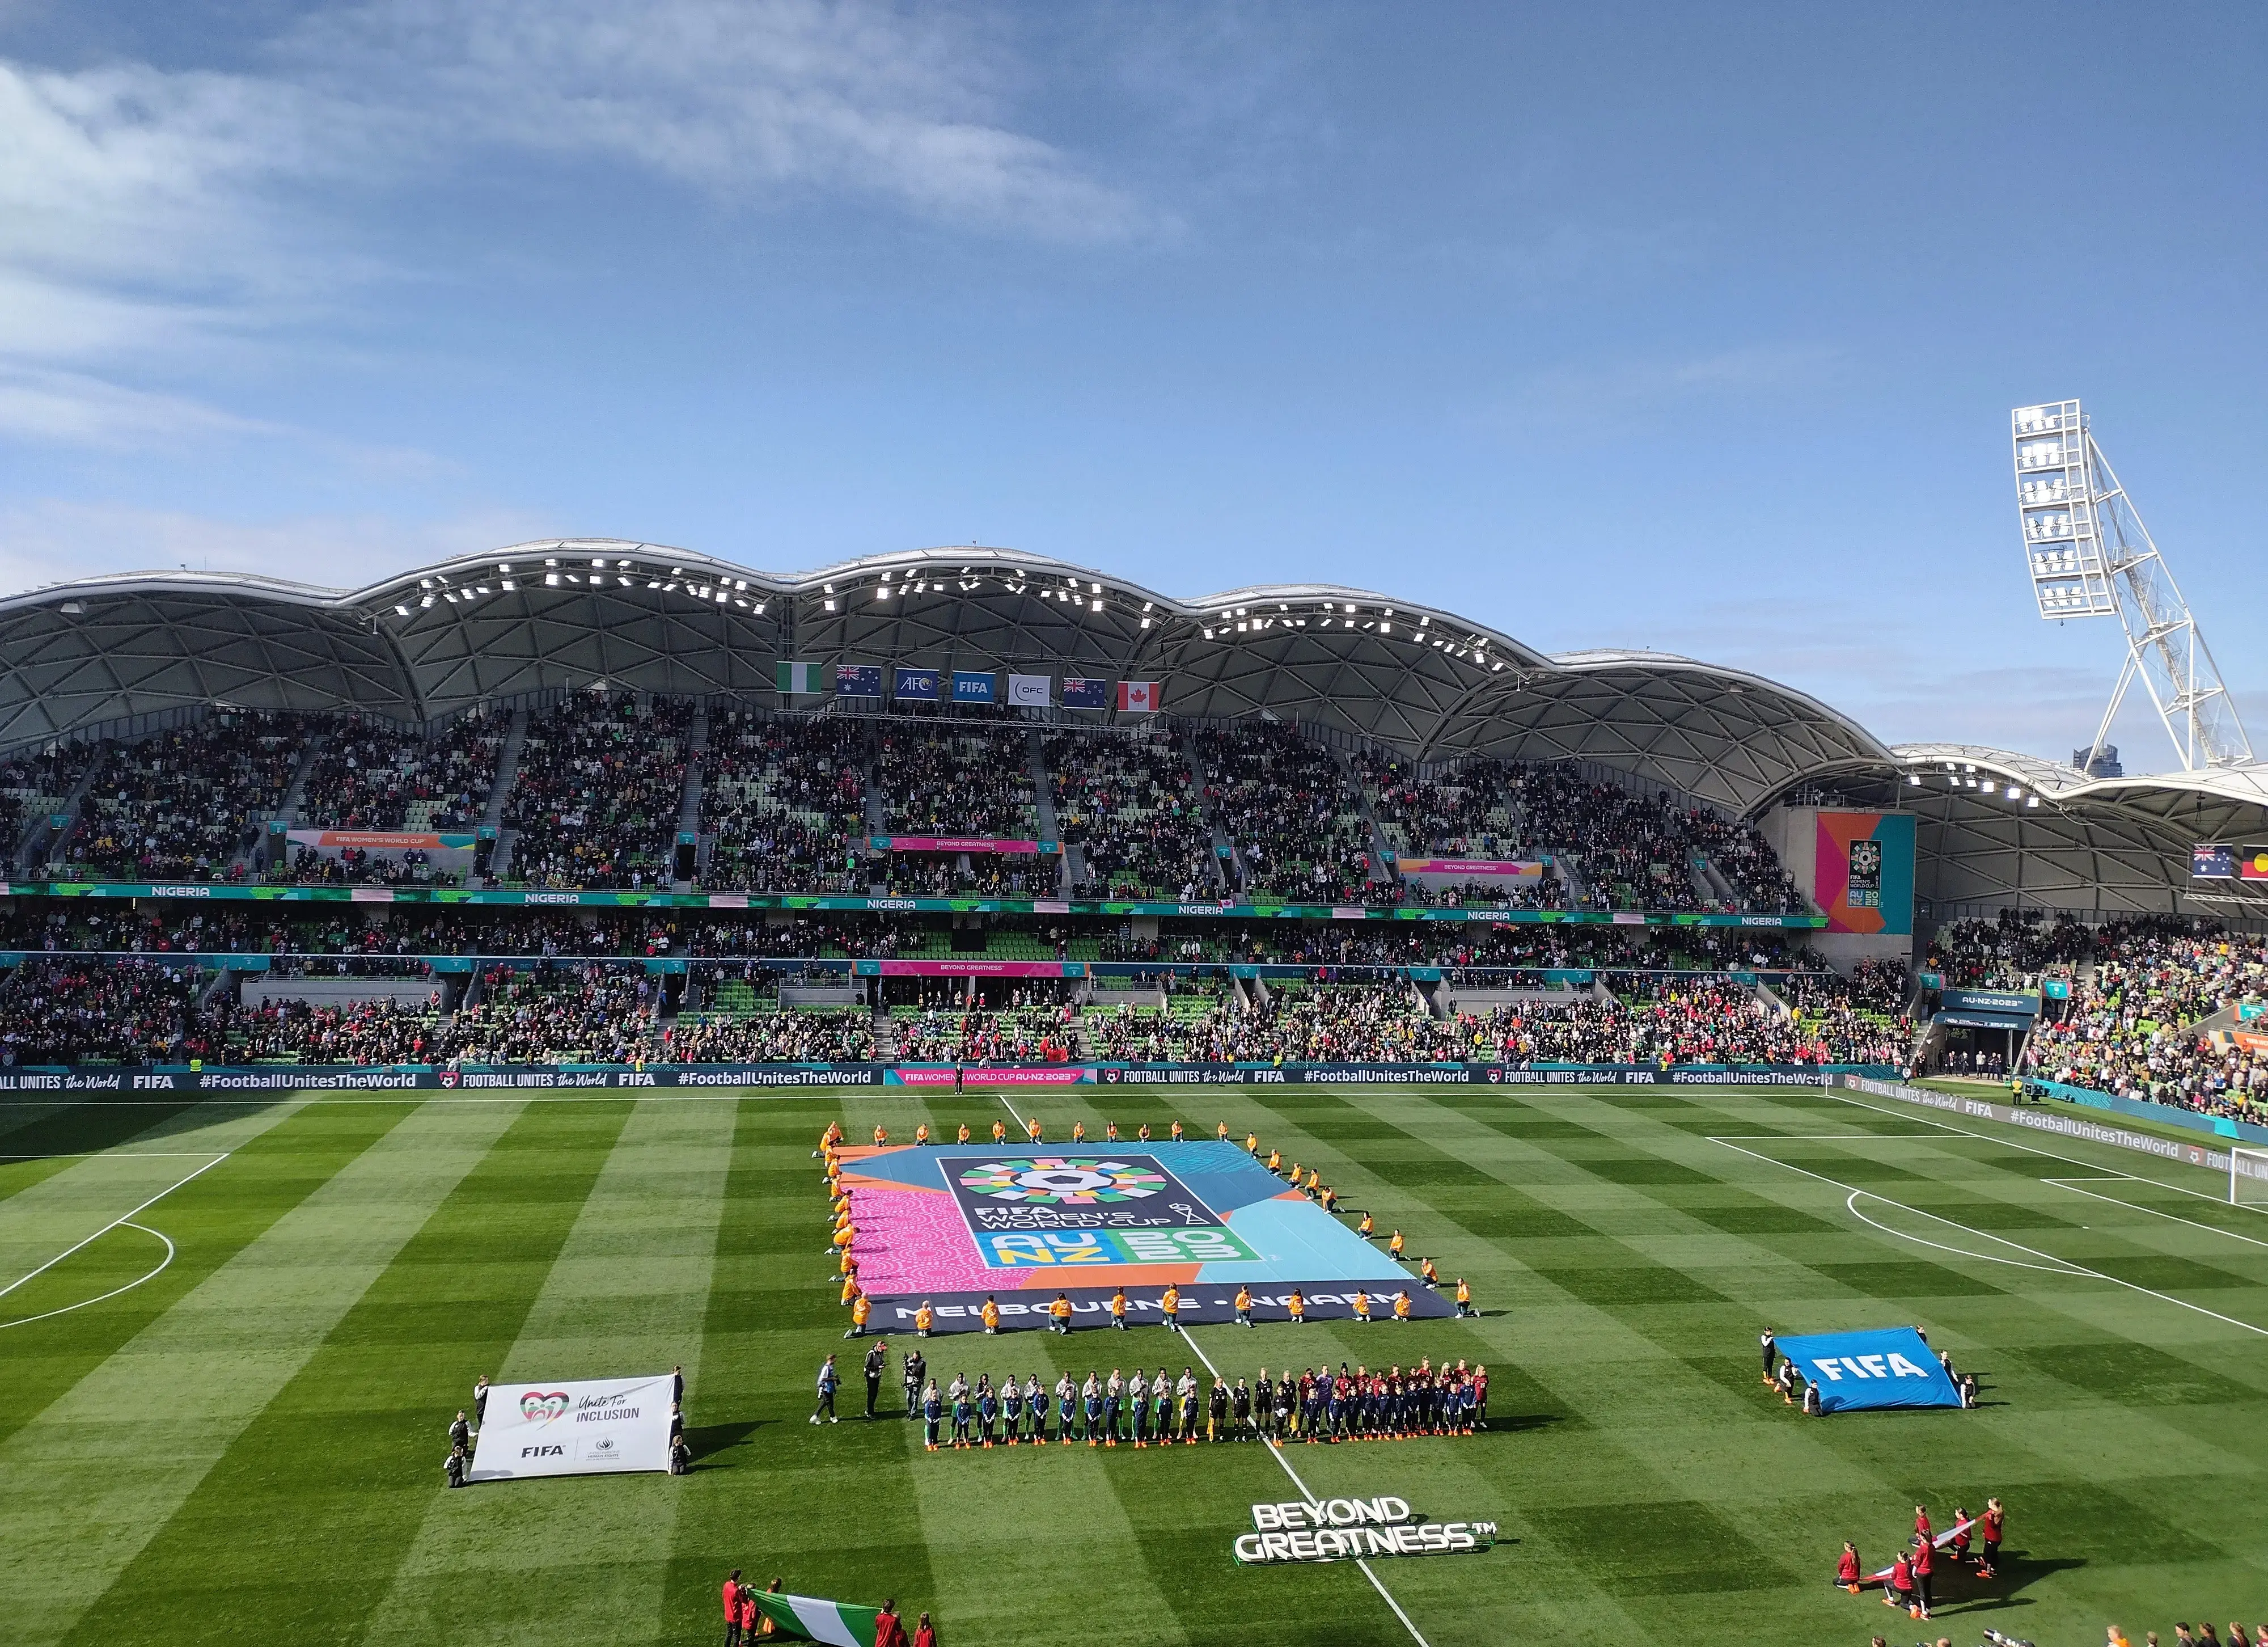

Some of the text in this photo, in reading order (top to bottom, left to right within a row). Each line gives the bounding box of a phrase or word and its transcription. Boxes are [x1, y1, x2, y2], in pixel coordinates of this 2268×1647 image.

[900, 677, 933, 691] AFC
[959, 682, 988, 694] FIFA
[152, 886, 210, 897] NIGERIA
[525, 894, 579, 903] NIGERIA
[867, 899, 916, 909] NIGERIA
[1179, 906, 1224, 915] NIGERIA
[1467, 911, 1510, 920] NIGERIA
[1742, 917, 1783, 926] NIGERIA
[20, 1075, 61, 1089] UNITES
[64, 1075, 84, 1088] the
[86, 1074, 121, 1089] World
[133, 1075, 175, 1088] FIFA
[200, 1074, 417, 1088] #FootballUnitesTheWorld
[463, 1072, 608, 1087] FOOTBALL UNITES the World
[619, 1073, 656, 1086] FIFA
[678, 1071, 871, 1086] #FootballUnitesTheWorld
[1124, 1069, 1245, 1083] FOOTBALL UNITES the World
[1254, 1070, 1285, 1083] FIFA
[1304, 1070, 1470, 1082] #FootballUnitesTheWorld
[1505, 1070, 1617, 1084] FOOTBALL UNITES the World
[1626, 1072, 1655, 1084] FIFA
[1673, 1072, 1834, 1086] #FootballUnitesTheWorld
[1861, 1079, 1958, 1111] FOOTBALL UNITES the World
[1965, 1101, 1993, 1118] FIFA
[2011, 1110, 2178, 1158] #FootballUnitesTheWorld
[974, 1206, 1057, 1215] FIFA
[977, 1211, 1135, 1222] WOMEN'S
[981, 1219, 1102, 1230] WORLD
[991, 1232, 1096, 1250] AU
[996, 1247, 1111, 1265] NZ
[1812, 1353, 1929, 1380] FIFA
[578, 1394, 627, 1410] Unite For
[576, 1408, 640, 1422] INCLUSION
[521, 1445, 564, 1459] FIFA
[1252, 1497, 1410, 1531] BEYOND
